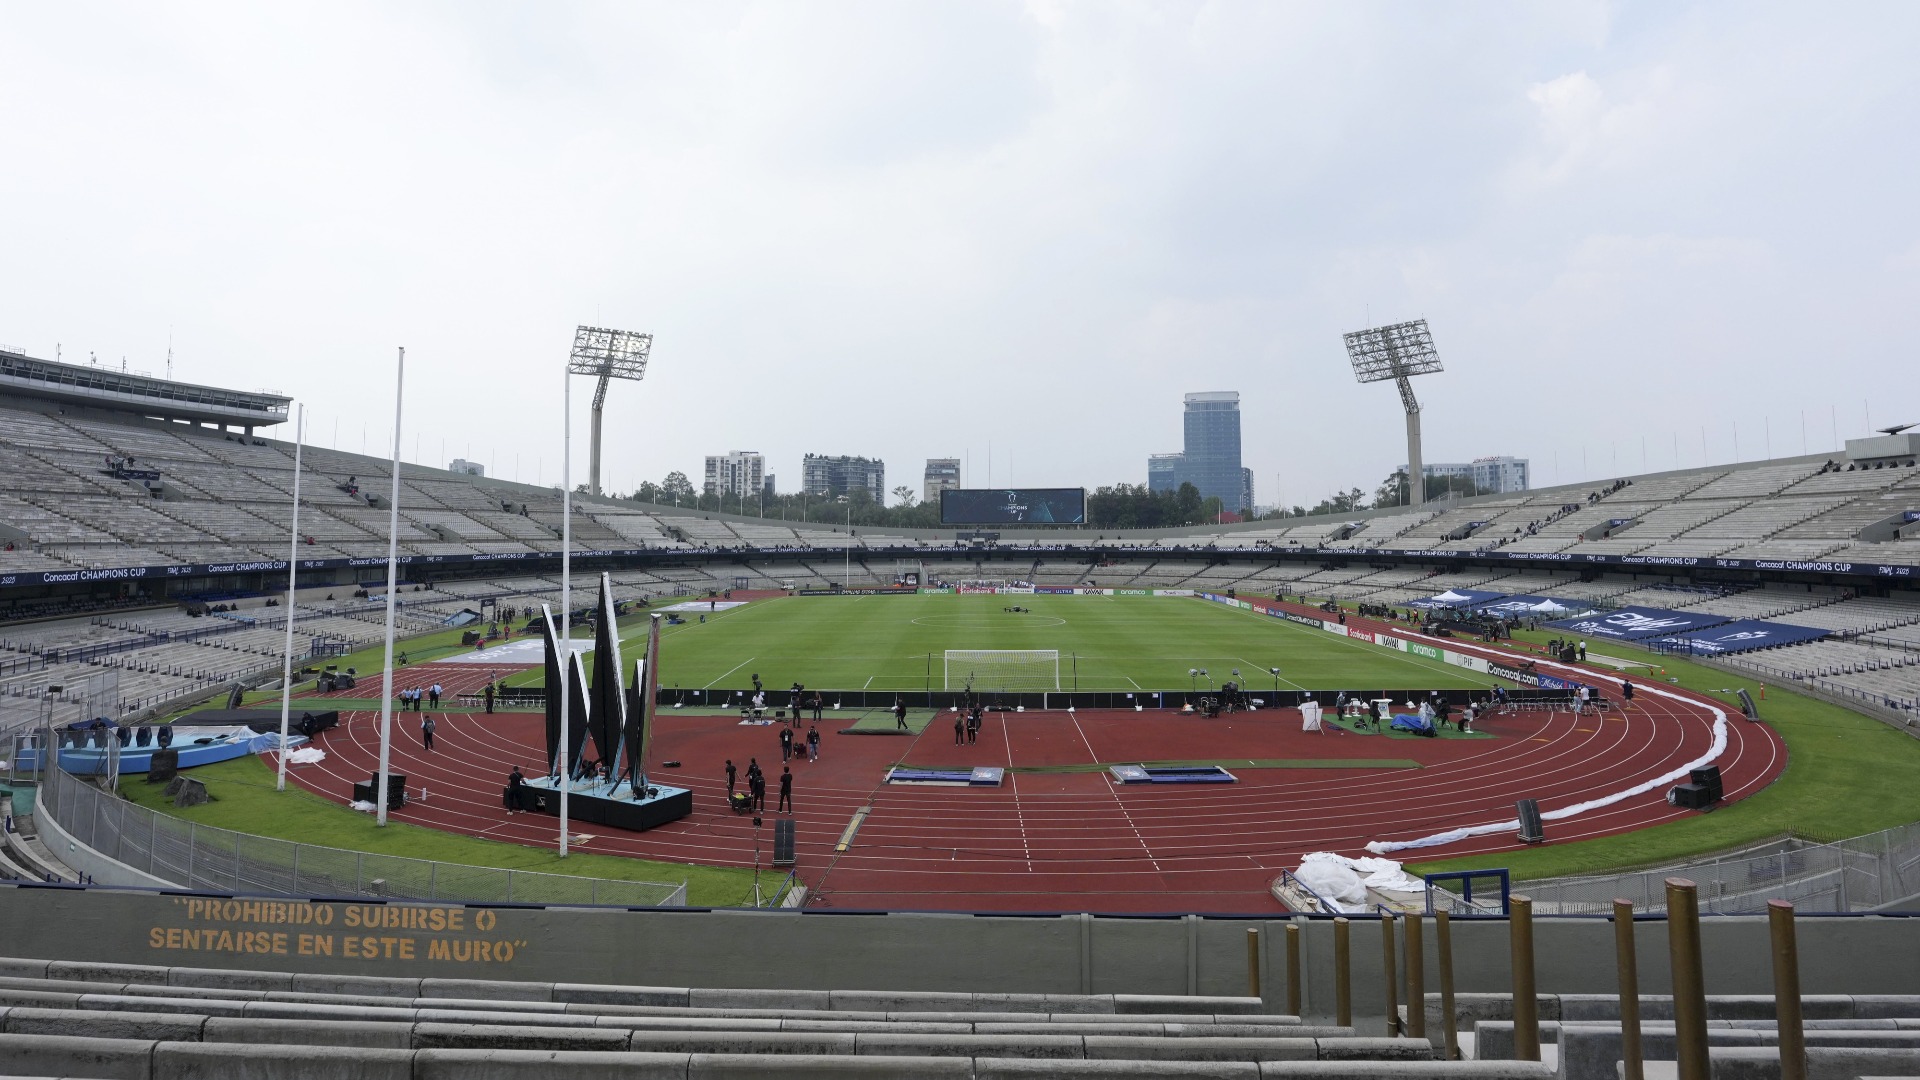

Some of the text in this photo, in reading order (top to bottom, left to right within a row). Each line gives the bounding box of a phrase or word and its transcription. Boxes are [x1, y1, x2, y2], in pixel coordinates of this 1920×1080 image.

[349, 556, 412, 566] Concacaf CHAMPS CUP
[1529, 553, 1560, 561] CHAMPIONS
[1646, 556, 1683, 565] CHAMPIONS
[208, 561, 287, 573] Concacaf CHAMPIONS CUP
[1755, 560, 1851, 572] Concacaf CHAMPIONS CUP
[43, 567, 146, 582] Concacaf CHAMPIONS CUP
[1349, 628, 1373, 643] Scotiabank
[1412, 642, 1437, 658] aramco
[1463, 656, 1473, 667] PIF
[343, 905, 465, 931] SUBIRSE
[475, 909, 497, 931] O
[149, 927, 288, 954] SENTARSE
[298, 933, 333, 956] EN
[343, 936, 416, 959] ESTE
